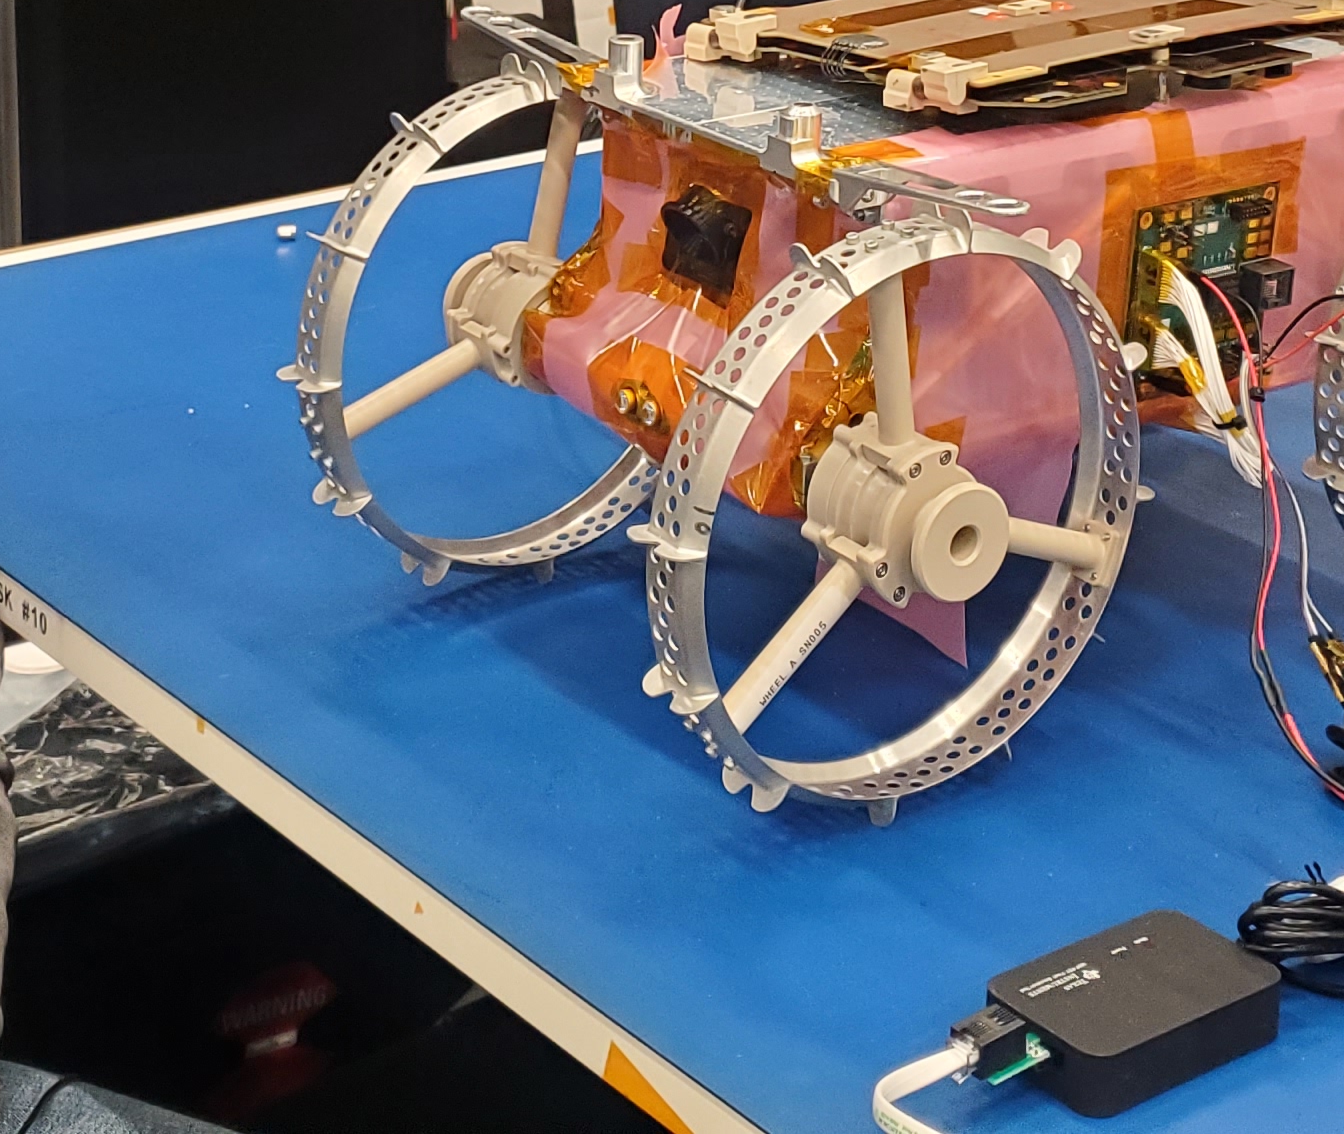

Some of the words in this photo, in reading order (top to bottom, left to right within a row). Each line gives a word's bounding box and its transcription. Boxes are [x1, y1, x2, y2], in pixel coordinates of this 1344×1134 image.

[22, 599, 47, 635] #10
[759, 674, 787, 707] WHEEL
[799, 620, 827, 656] SN005
